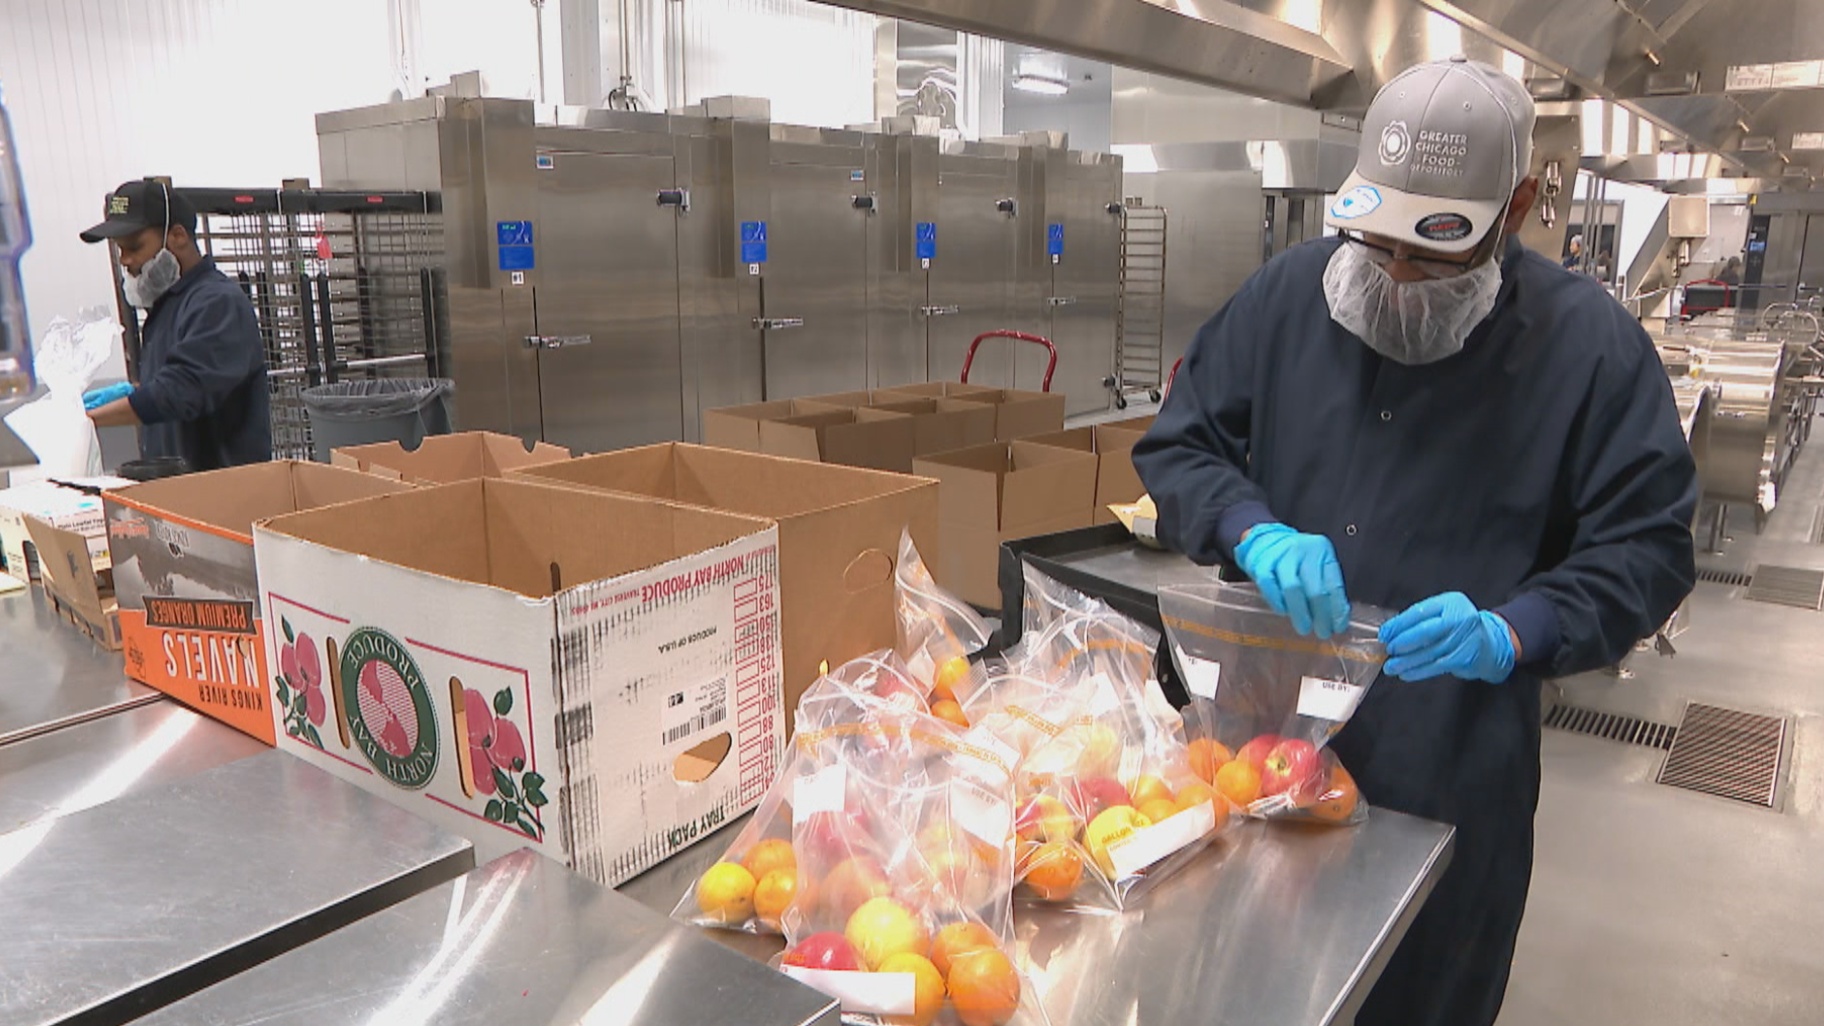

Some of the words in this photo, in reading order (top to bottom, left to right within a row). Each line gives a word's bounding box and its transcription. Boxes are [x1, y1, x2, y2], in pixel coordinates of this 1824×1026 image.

[1420, 130, 1467, 145] GREATER
[1415, 141, 1467, 156] CHICAGO
[694, 566, 712, 587] BAY
[714, 554, 743, 580] NORTH
[641, 572, 692, 602] PRODUCE
[759, 572, 773, 592] 175
[151, 600, 195, 625] ORANGES
[760, 592, 774, 612] 163
[196, 601, 247, 629] PREMIUM
[760, 613, 774, 633] 150
[677, 636, 687, 647] OF
[686, 625, 717, 645] PRODUCE
[760, 633, 775, 654] 138
[163, 631, 260, 689] NAVELS
[347, 634, 419, 690] PRODUCE
[761, 654, 775, 674] 125
[761, 674, 776, 694] 113
[199, 684, 228, 706] RIVER
[231, 689, 263, 711] KINGS
[762, 693, 776, 714] 100
[763, 714, 774, 734] 88
[350, 715, 378, 759] BAY
[763, 734, 774, 753] 80
[386, 741, 434, 783] NORTH
[701, 805, 725, 834] TRAY
[667, 818, 697, 852] PACK
